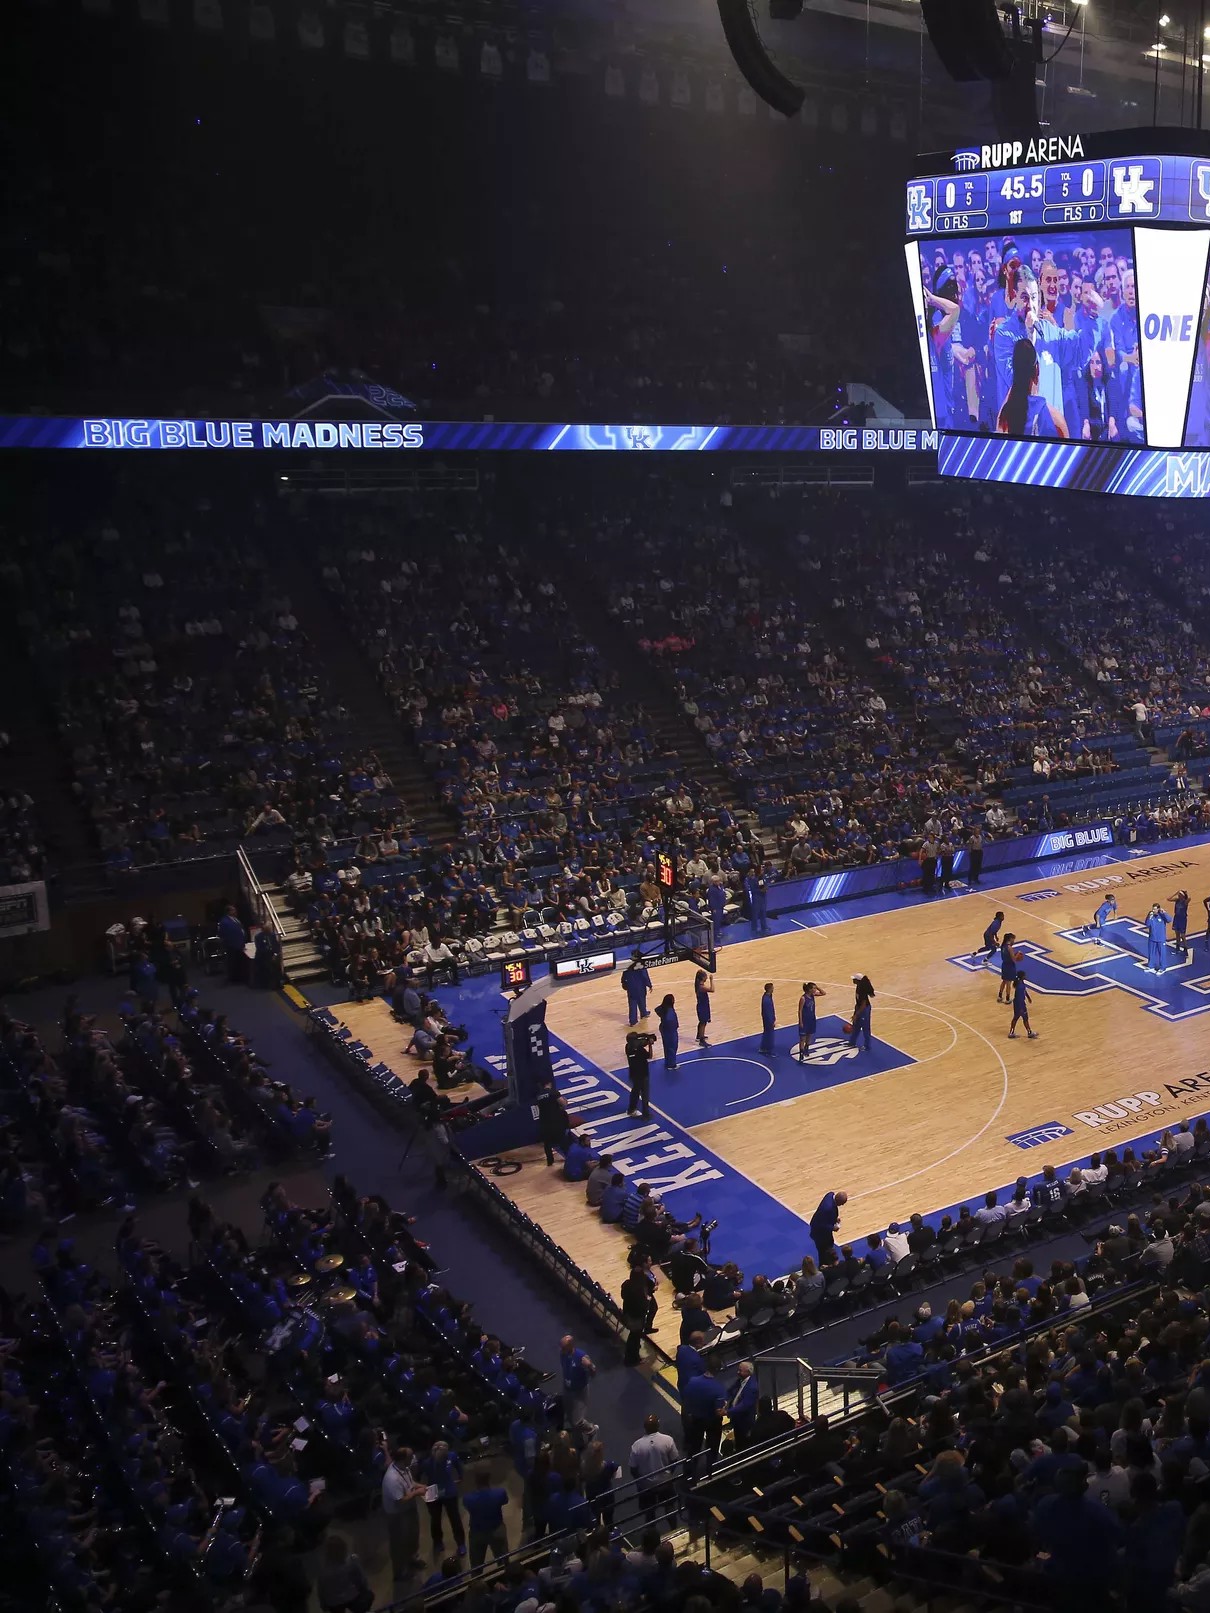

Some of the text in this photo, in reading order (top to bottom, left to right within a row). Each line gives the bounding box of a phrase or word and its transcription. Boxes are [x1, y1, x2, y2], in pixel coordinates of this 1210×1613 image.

[981, 134, 1085, 169] RUPP ARENA
[964, 181, 974, 190] TOL
[1000, 174, 1043, 199] 45.5
[1060, 172, 1071, 181] TOL
[1082, 168, 1094, 197] 0
[945, 183, 956, 208] 0
[966, 192, 972, 206] 5
[1062, 185, 1069, 197] 5
[1113, 165, 1154, 214] UK
[944, 216, 969, 229] 0 FLS
[1008, 210, 1023, 224] 1ST
[1064, 206, 1096, 221] FLS 0
[83, 419, 424, 448] BIG BLUE MADNESS
[820, 429, 858, 450] BIG
[862, 429, 917, 450] BLUE
[1050, 827, 1109, 851] BIG BLUE
[660, 864, 672, 886] 30
[1062, 875, 1124, 893] RUPP
[1126, 860, 1200, 880] ARENA
[510, 971, 523, 983] 30
[1072, 1091, 1162, 1128] RUPP
[1099, 1103, 1181, 1136] LEXINGTON,
